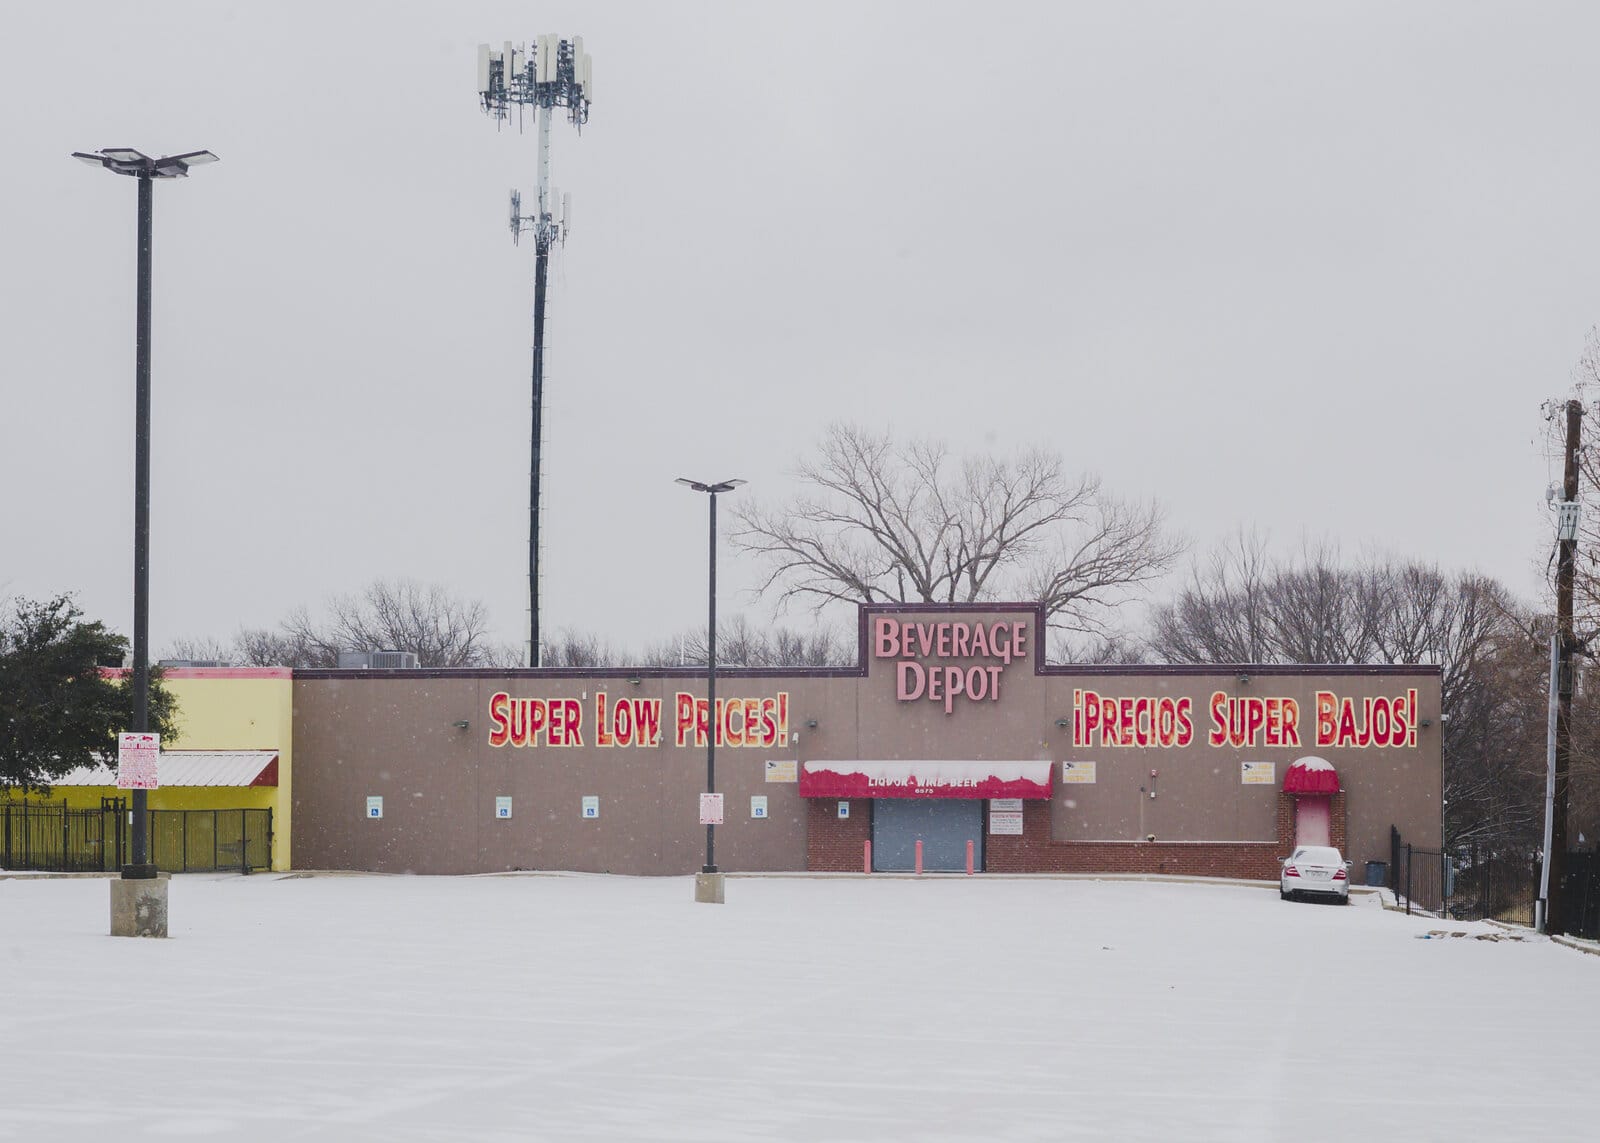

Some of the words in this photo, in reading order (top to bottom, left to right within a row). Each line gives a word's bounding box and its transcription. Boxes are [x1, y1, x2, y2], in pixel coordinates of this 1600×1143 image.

[875, 617, 1026, 664] BEVERAGE
[896, 661, 1004, 714] DEPOT
[488, 691, 585, 748] SUPER
[595, 691, 662, 748] LOW
[675, 691, 790, 748] PRICES!
[1072, 688, 1194, 748] ¡PRECIOS
[1208, 690, 1302, 748] SUPER
[1315, 687, 1419, 748] BAJOS!
